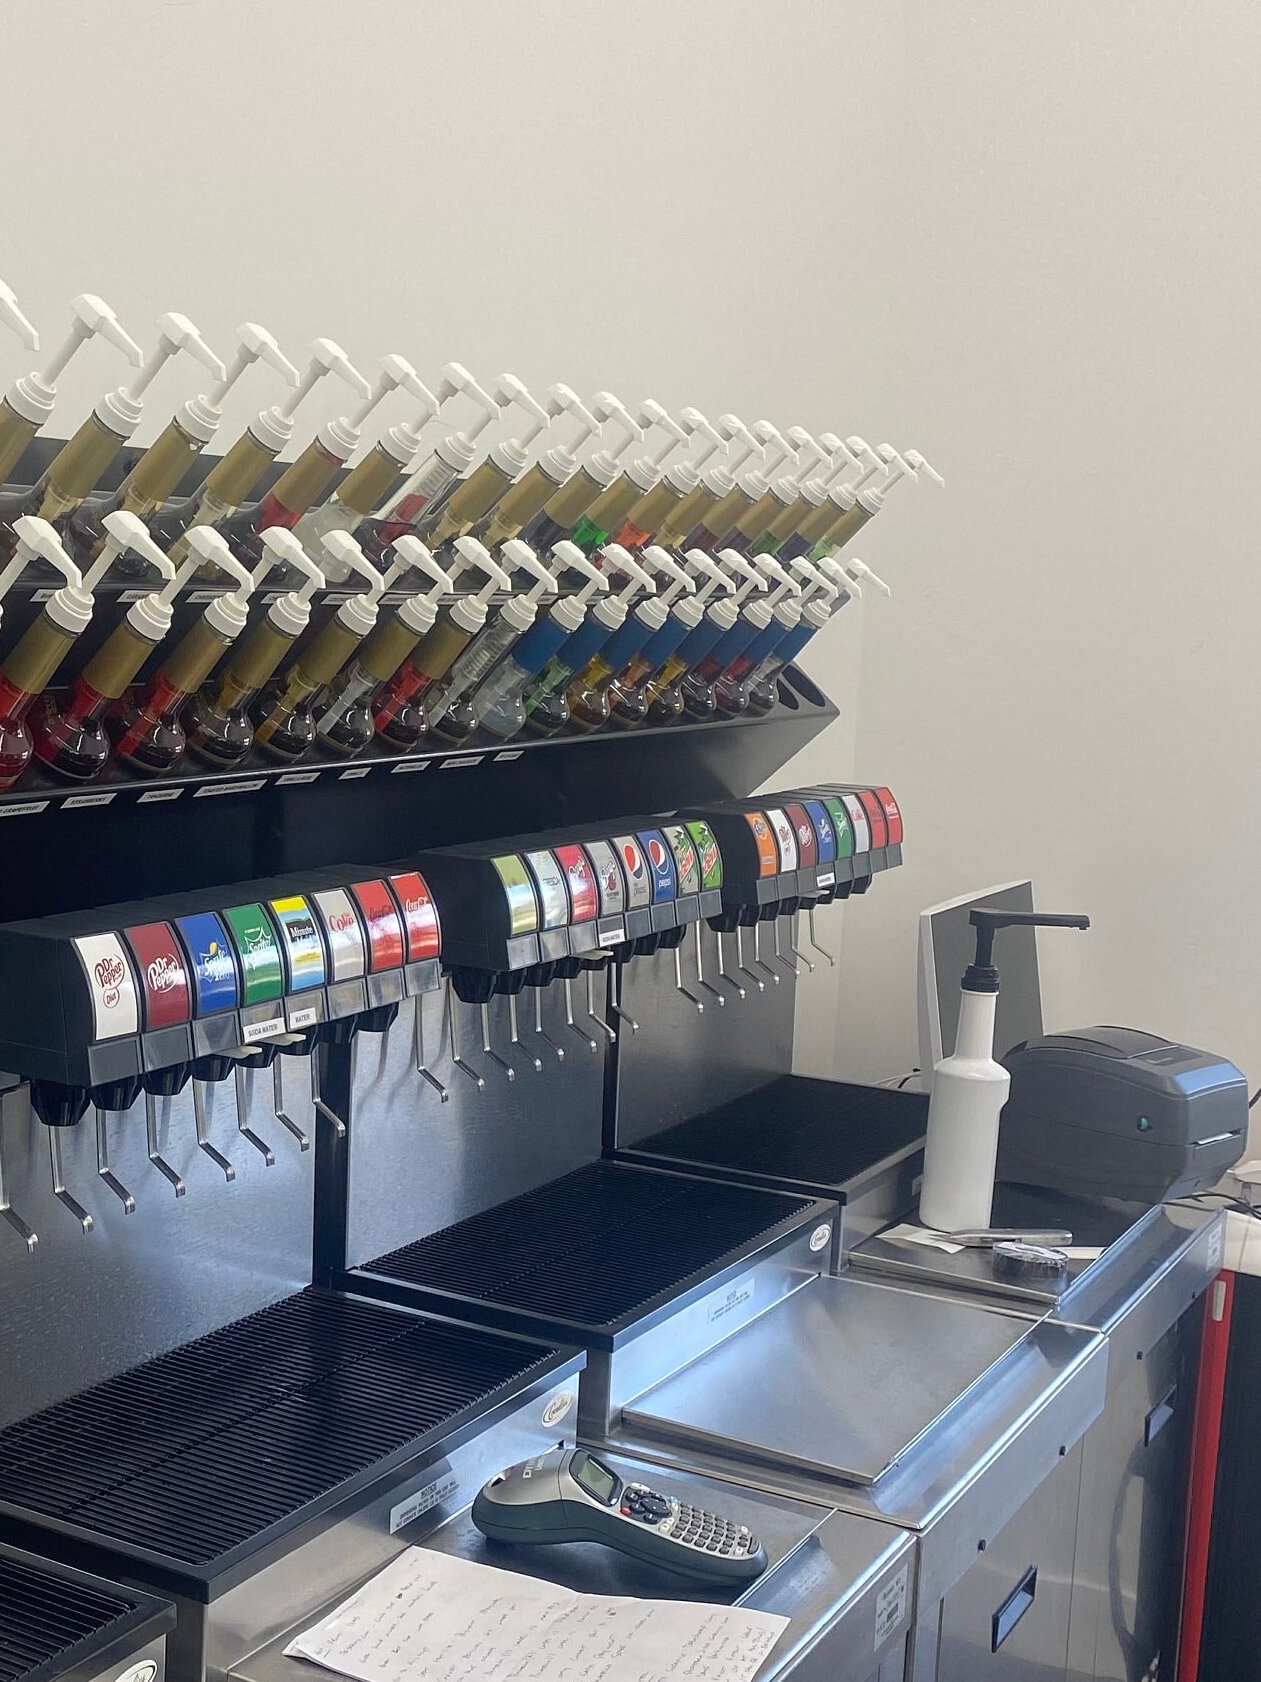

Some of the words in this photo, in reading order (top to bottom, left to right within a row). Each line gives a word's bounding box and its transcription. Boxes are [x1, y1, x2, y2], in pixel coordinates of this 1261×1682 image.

[95, 961, 123, 988] Pepper
[102, 957, 113, 973] Dr
[156, 957, 168, 972] Dr
[149, 961, 178, 991] Pepper
